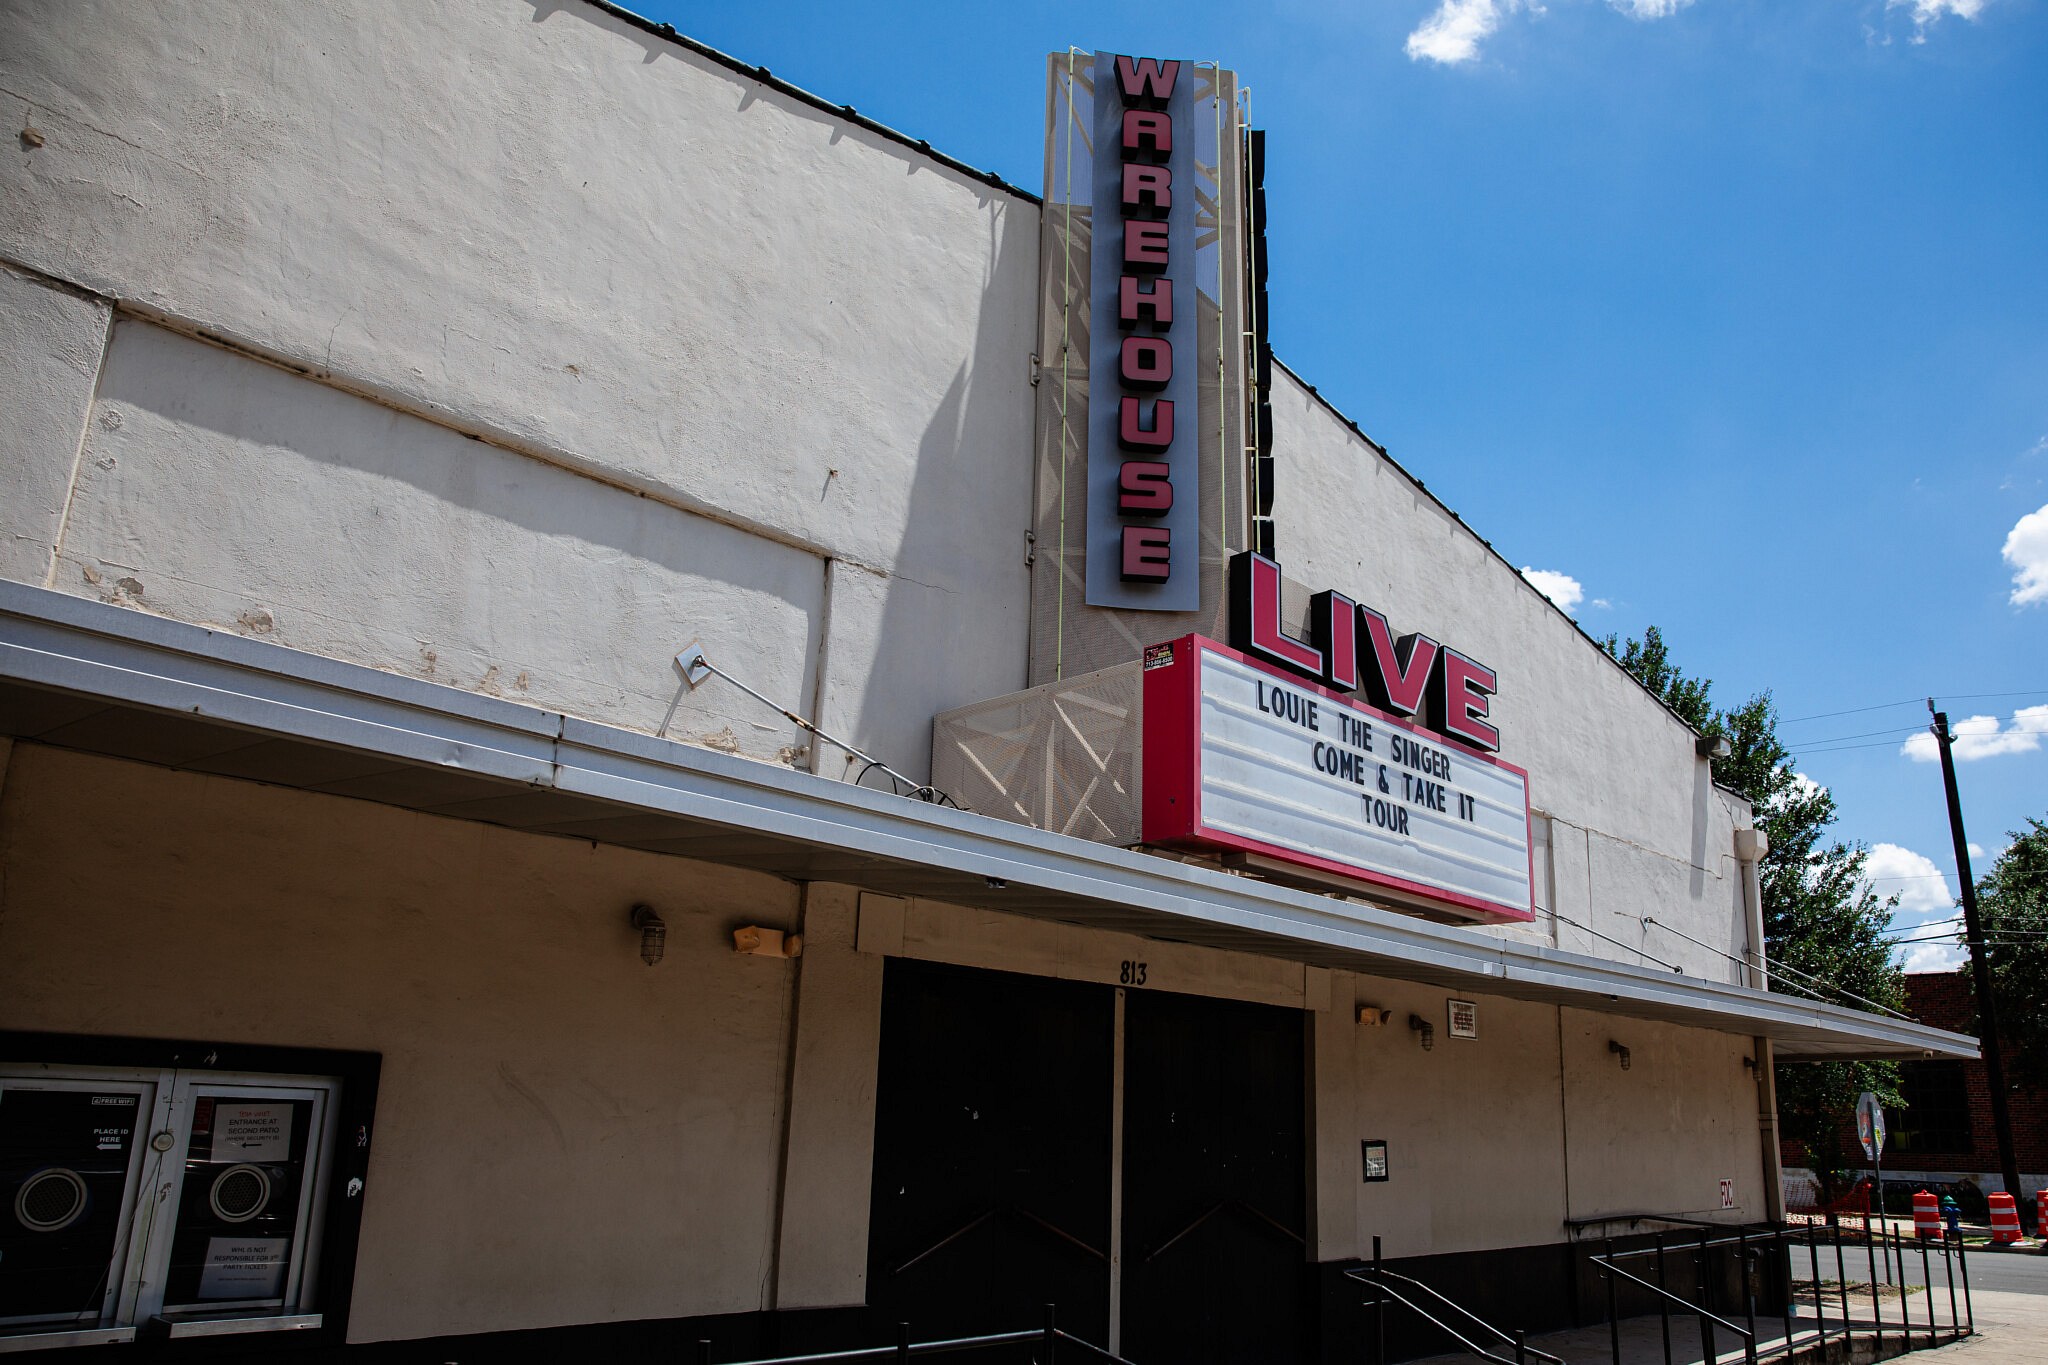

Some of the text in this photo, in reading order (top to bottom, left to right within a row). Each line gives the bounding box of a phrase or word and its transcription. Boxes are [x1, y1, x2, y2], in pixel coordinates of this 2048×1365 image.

[1114, 54, 1181, 584] WAREHOUSE
[1229, 550, 1500, 752] LIVE
[1257, 679, 1452, 782] LOUIE THE SINGER
[1313, 741, 1475, 822] COME & TAKE IT
[1361, 793, 1410, 836] TOUR
[1120, 960, 1148, 985] 813
[228, 1127, 258, 1135] SECOND
[229, 1118, 267, 1126] ENTRANCE
[1720, 1180, 1733, 1206] FDC
